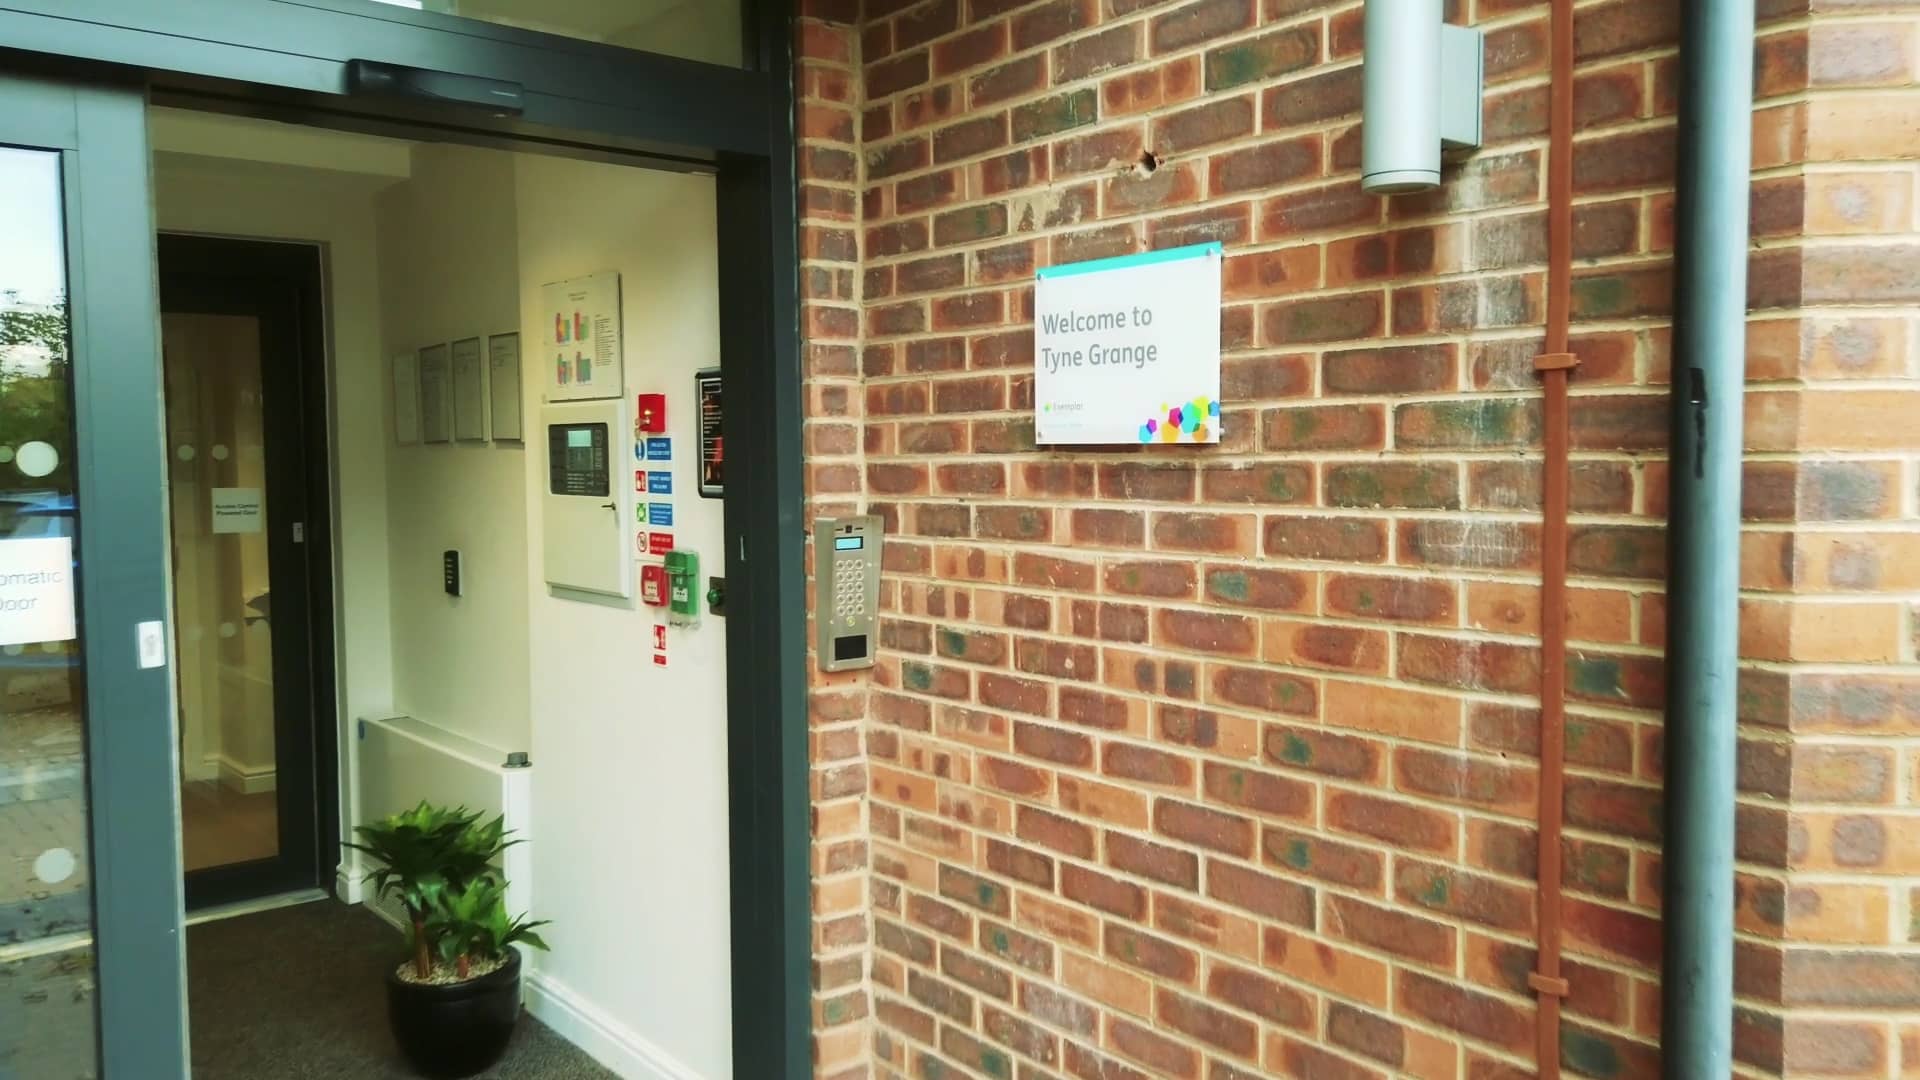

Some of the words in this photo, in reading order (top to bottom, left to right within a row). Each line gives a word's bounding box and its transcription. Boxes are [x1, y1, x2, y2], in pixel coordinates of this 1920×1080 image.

[1042, 310, 1126, 335] Welcome
[1132, 306, 1153, 326] to
[1042, 347, 1083, 374] Tyne
[1088, 343, 1157, 369] Grange
